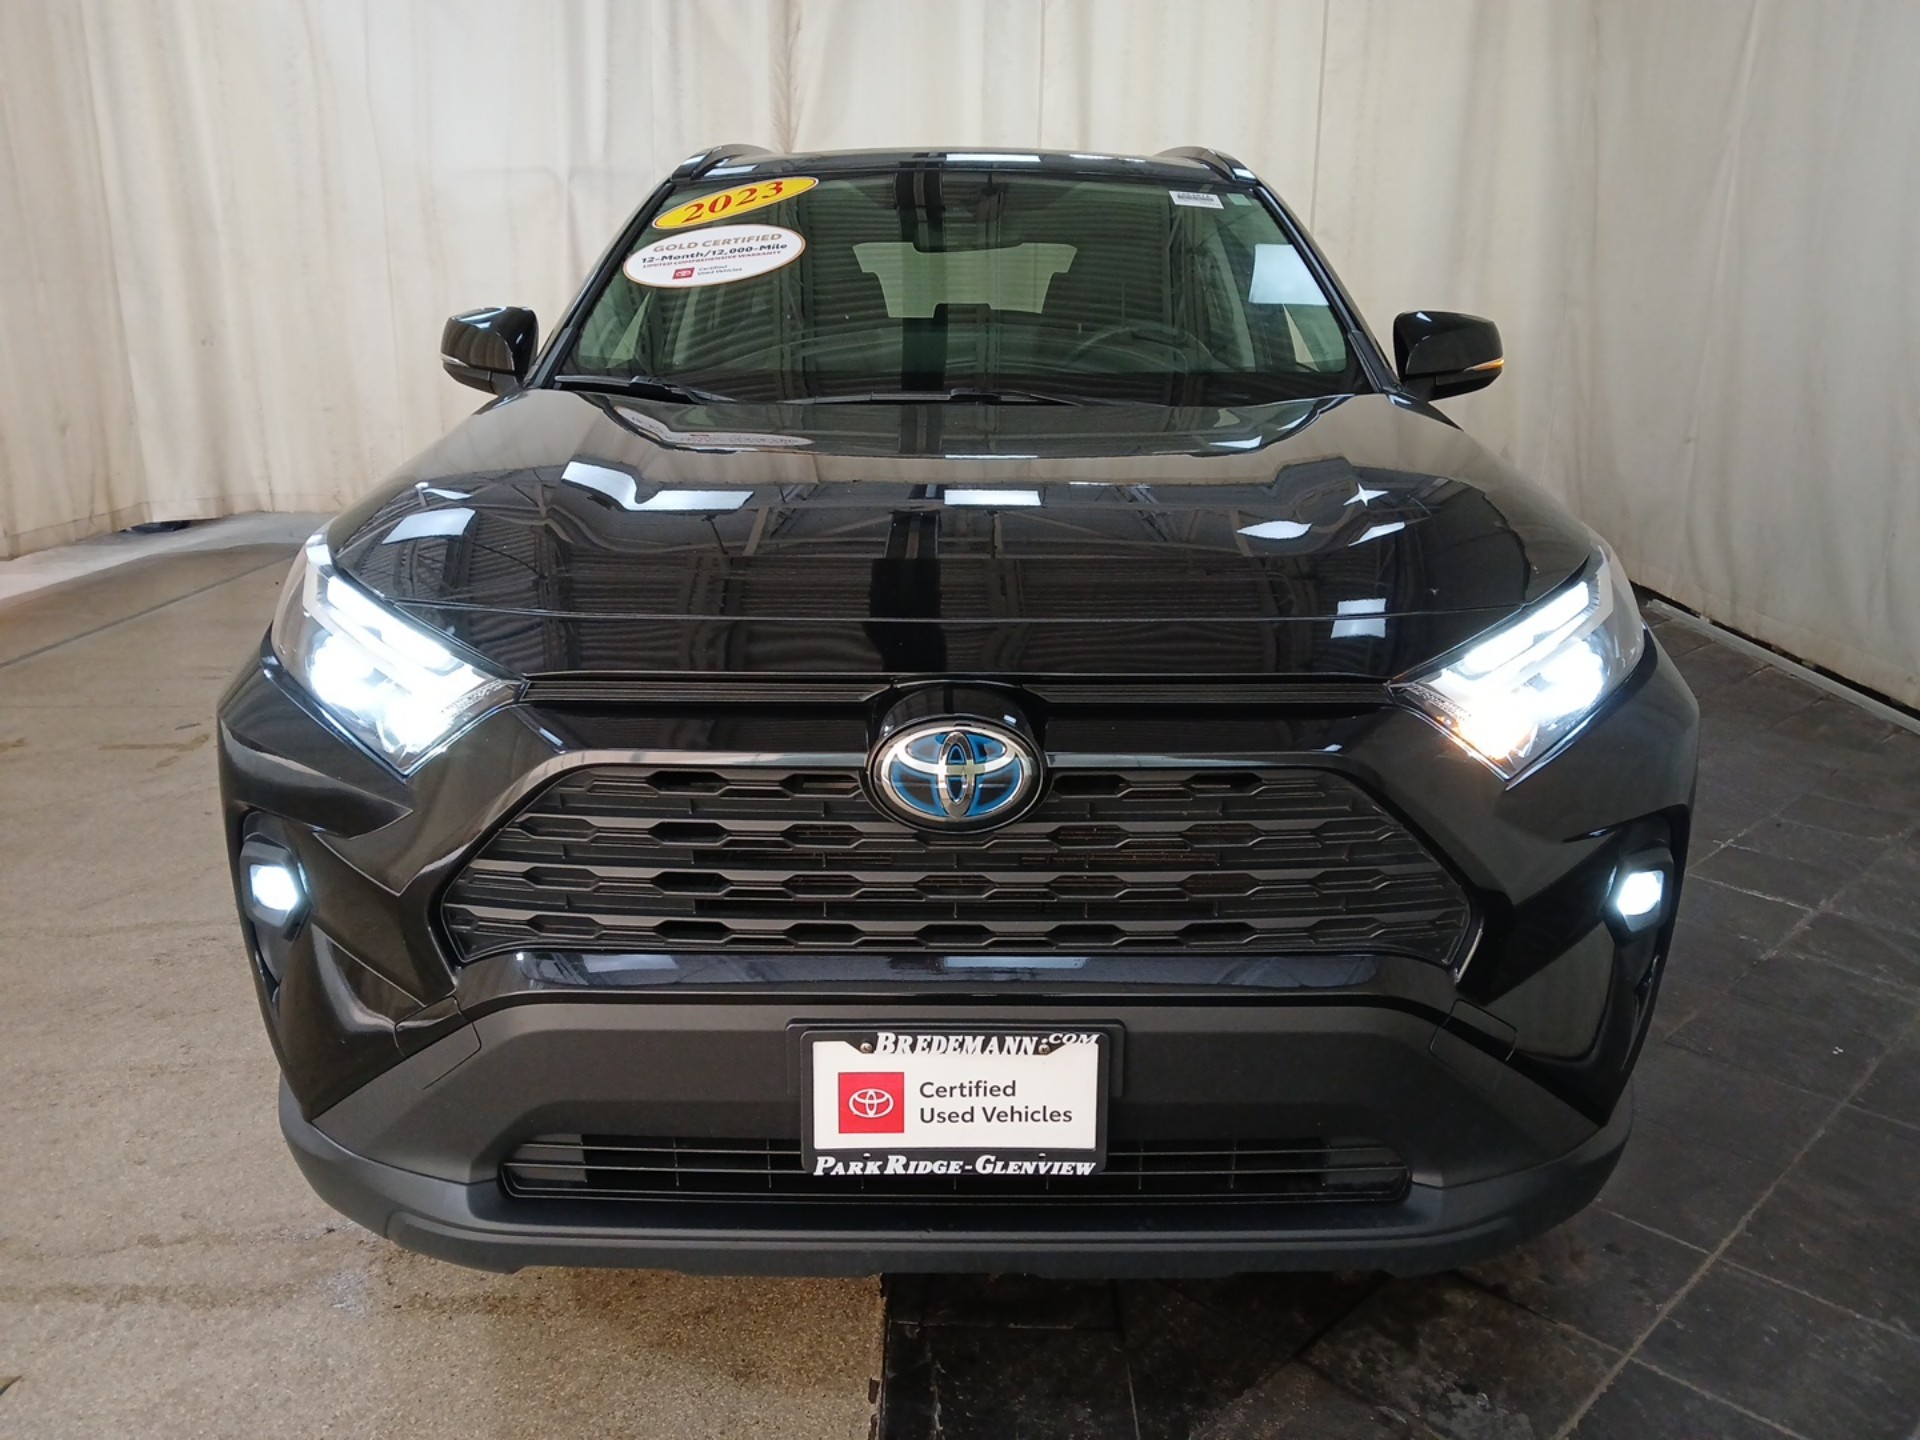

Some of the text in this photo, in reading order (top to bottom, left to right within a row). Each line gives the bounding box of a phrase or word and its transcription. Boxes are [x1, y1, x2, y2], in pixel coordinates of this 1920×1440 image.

[682, 181, 784, 223] 2023
[653, 233, 782, 253] GOLD CERTIFIED
[919, 1080, 1016, 1098] Certified
[919, 1105, 1073, 1124] Used Vehicles
[813, 1155, 884, 1176] PARK
